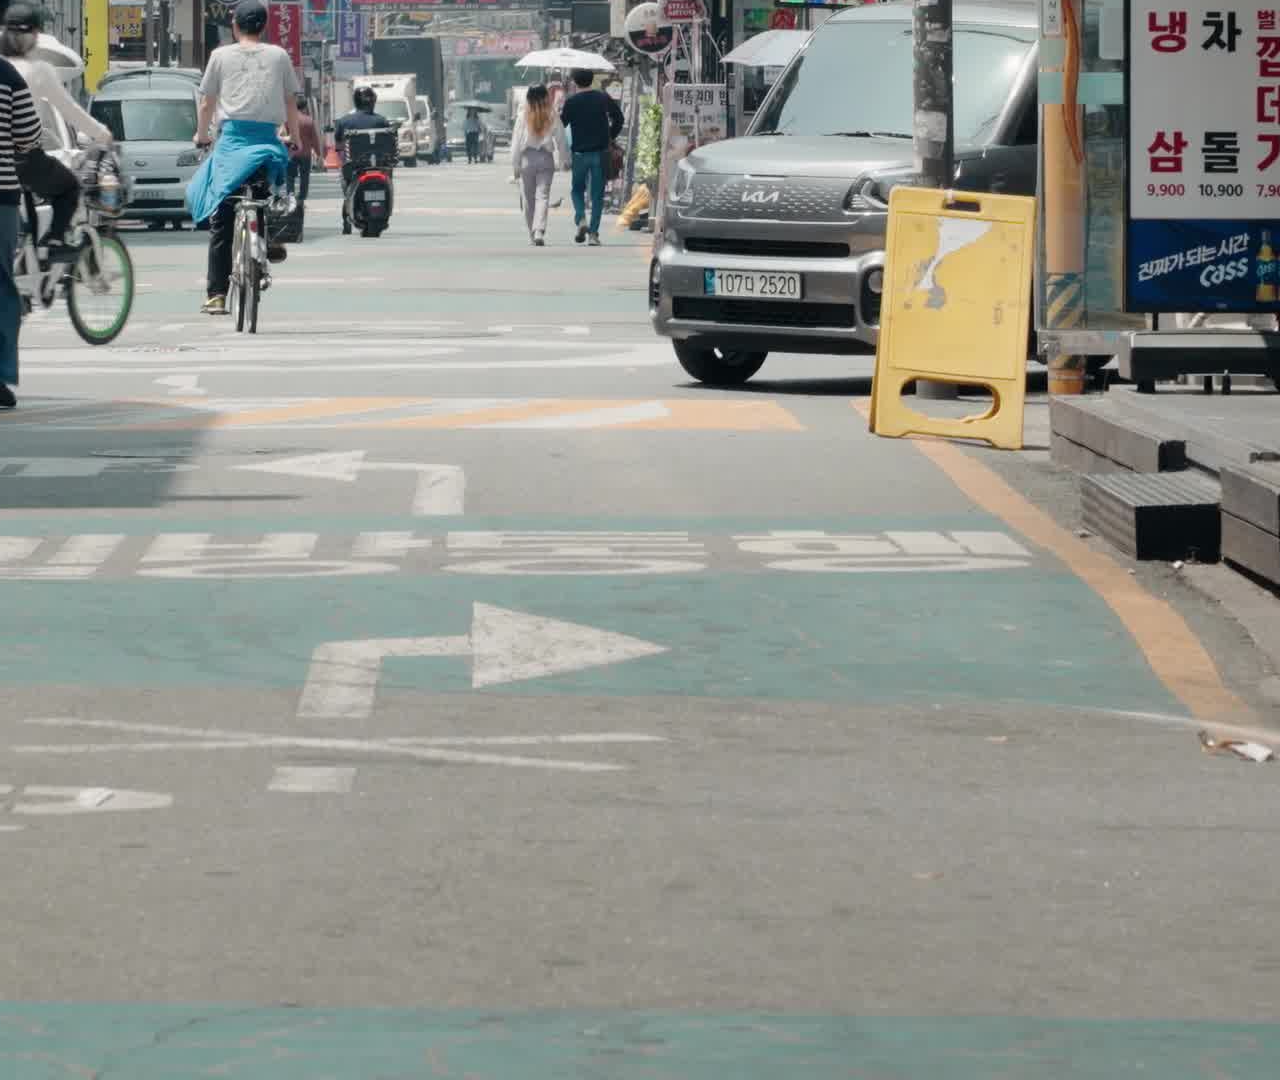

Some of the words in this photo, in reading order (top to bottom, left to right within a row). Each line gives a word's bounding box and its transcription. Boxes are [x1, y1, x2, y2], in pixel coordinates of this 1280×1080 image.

[1200, 10, 1243, 176] 차돌
[1147, 183, 1186, 199] 9,900
[1198, 183, 1244, 199] 10,900
[1137, 250, 1185, 283] 진짜가
[1185, 243, 1218, 270] 되는
[1218, 231, 1251, 260] 시간
[759, 274, 797, 295] 2520
[1199, 257, 1249, 290] Cass
